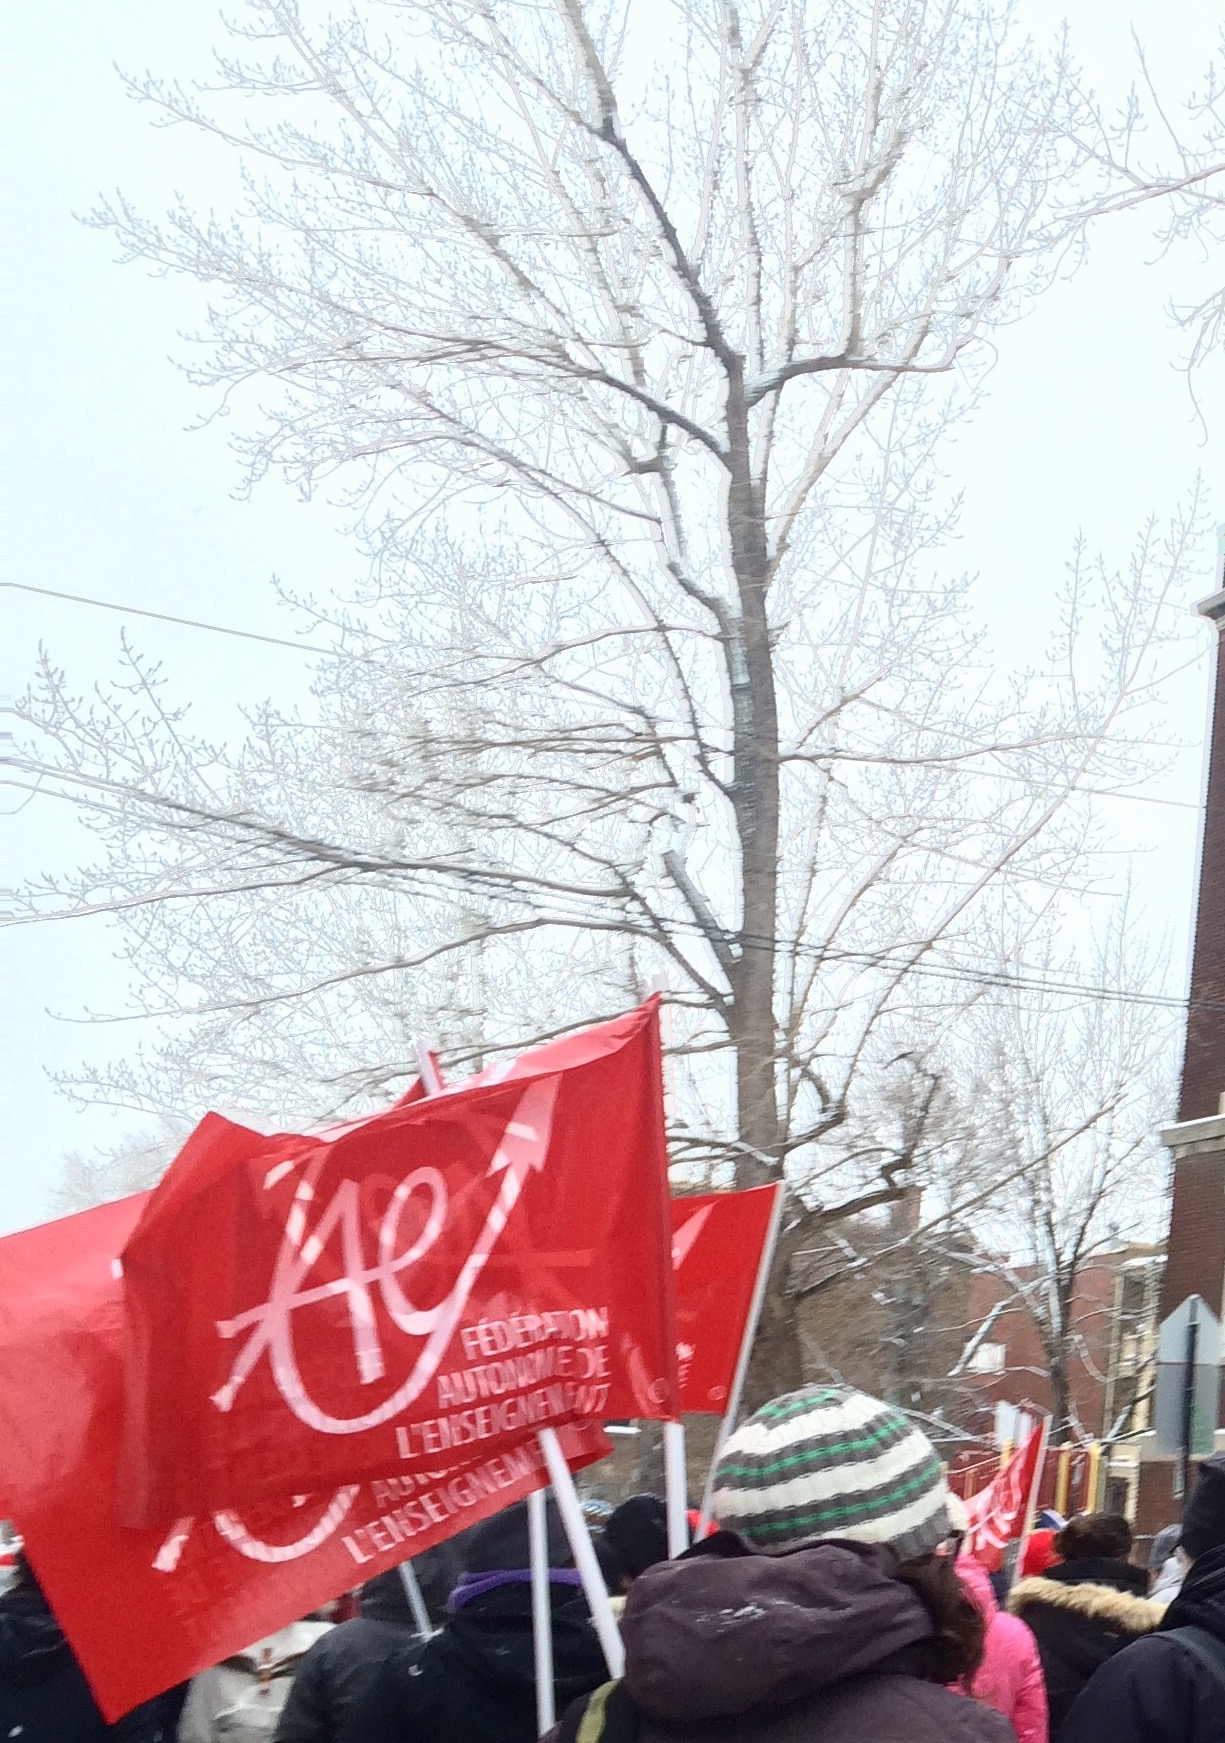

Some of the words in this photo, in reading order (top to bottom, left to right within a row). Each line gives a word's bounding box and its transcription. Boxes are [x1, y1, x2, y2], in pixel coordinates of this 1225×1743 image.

[460, 1306, 610, 1360] FÉDÉRATION
[437, 1345, 574, 1410] AUTONOME
[577, 1344, 612, 1378] DE
